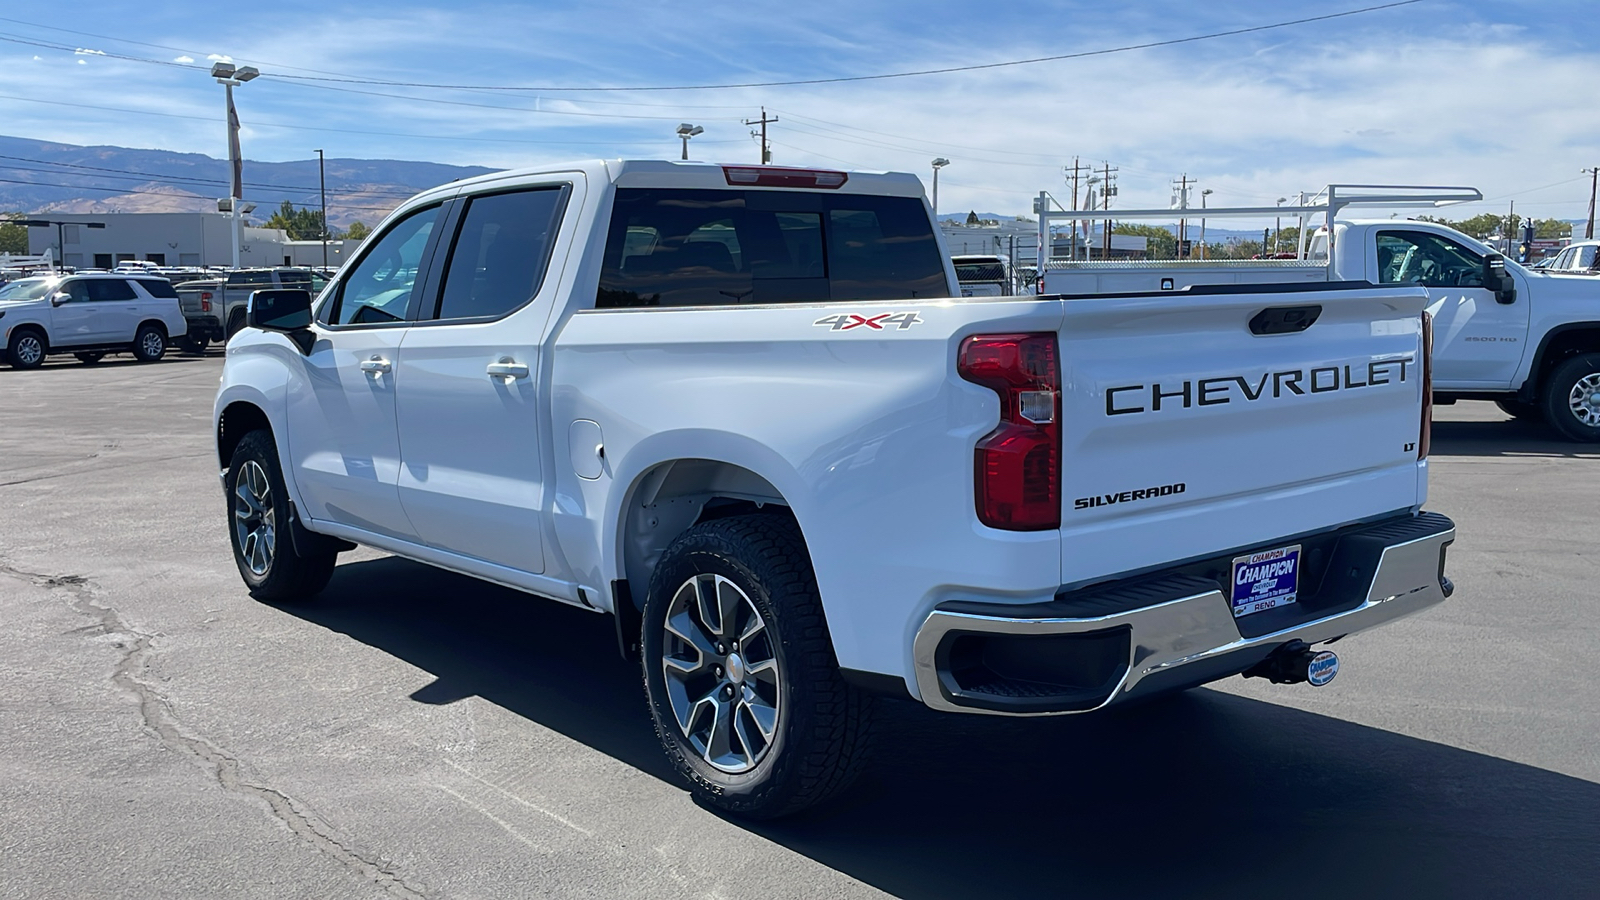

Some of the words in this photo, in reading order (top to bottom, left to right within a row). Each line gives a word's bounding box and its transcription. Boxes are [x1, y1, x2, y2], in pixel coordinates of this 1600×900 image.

[1106, 358, 1413, 415] CHEVROLET
[1403, 442, 1416, 453] LT
[1074, 483, 1186, 510] SILVERADO
[1251, 549, 1285, 563] CHAMPION
[1236, 559, 1295, 585] CHAMPION
[1253, 580, 1277, 591] CHEVROLET
[1254, 600, 1276, 611] RENO
